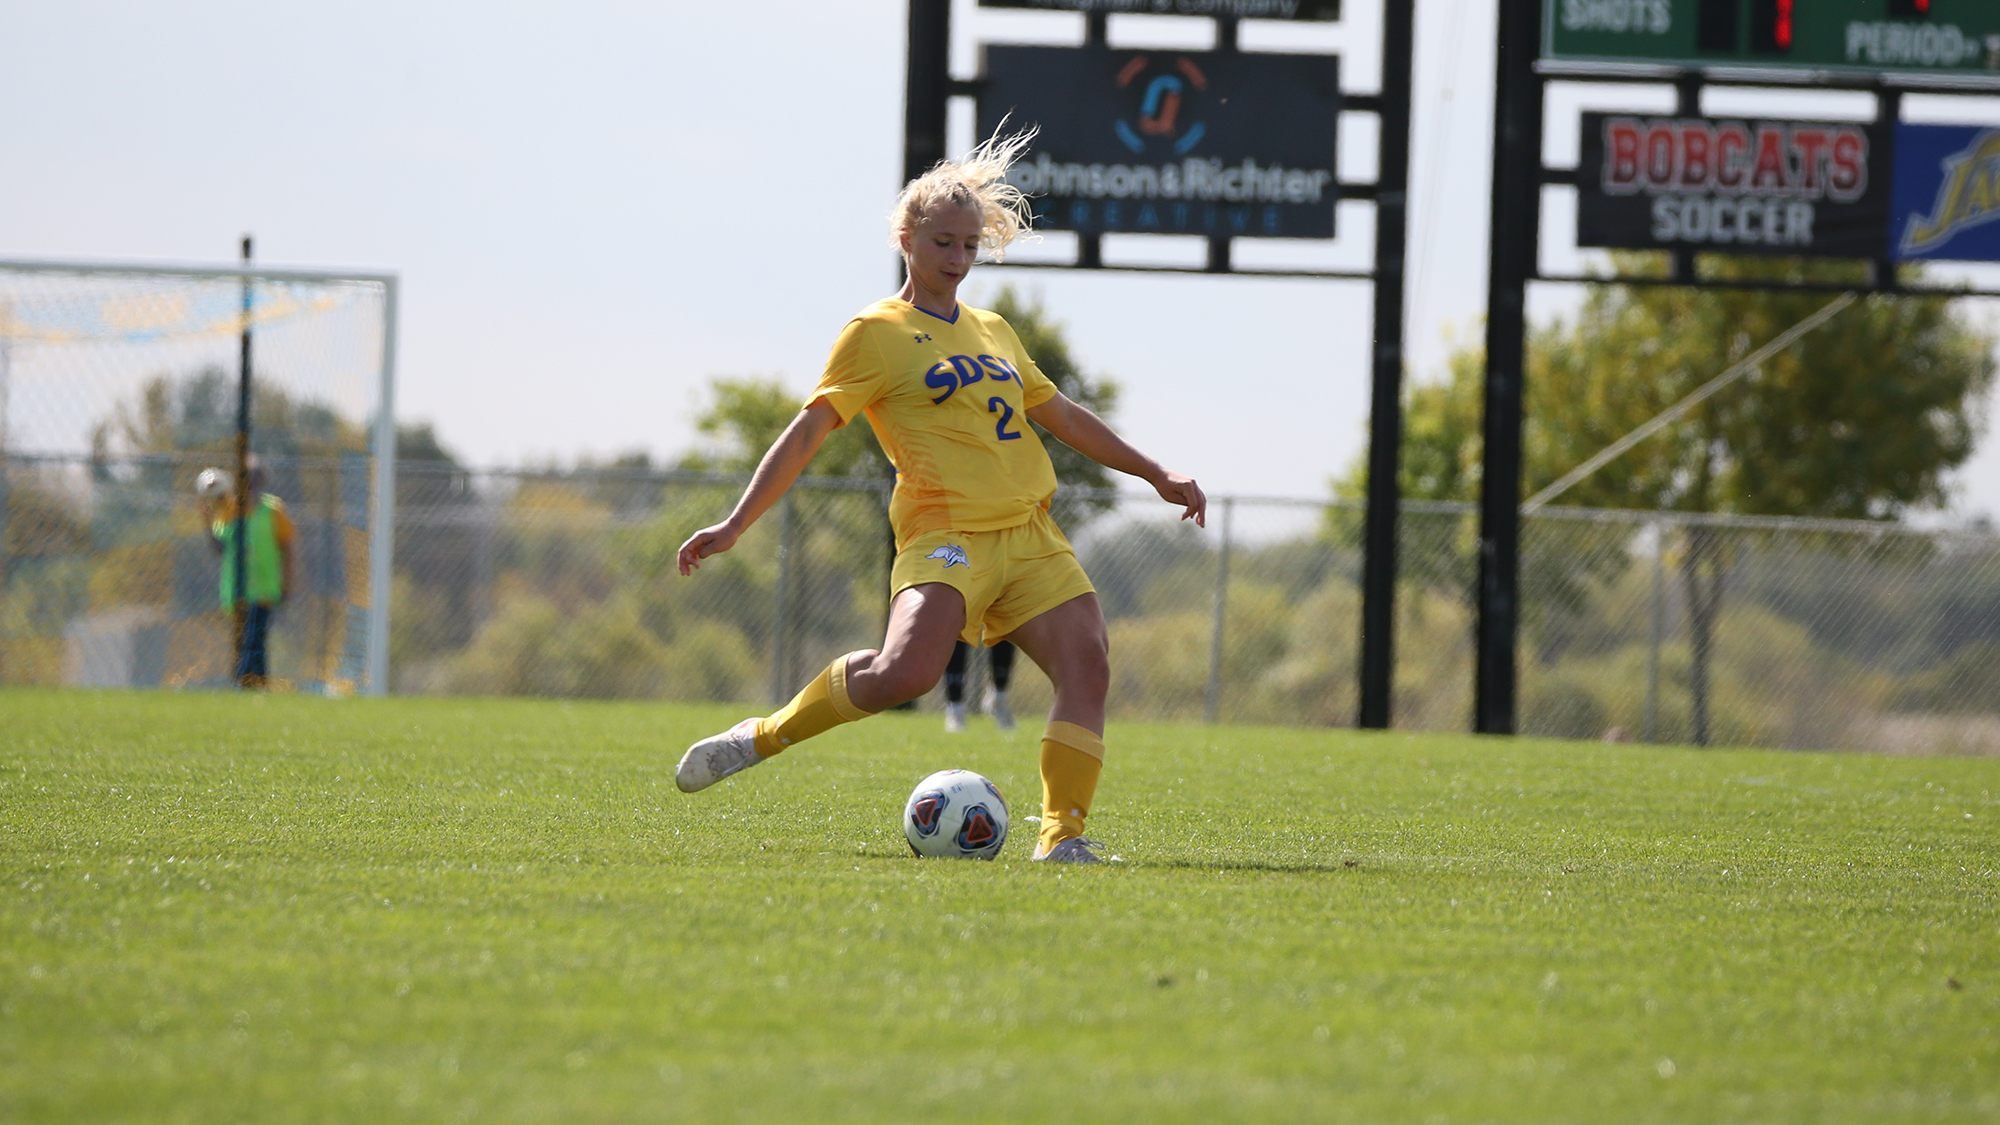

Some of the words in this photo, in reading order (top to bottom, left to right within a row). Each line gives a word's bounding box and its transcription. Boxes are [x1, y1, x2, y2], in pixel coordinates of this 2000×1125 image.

[1561, 0, 1672, 34] SHOTS
[1845, 21, 1963, 66] PERIOD
[1003, 152, 1330, 202] ohnson&Richter
[1603, 117, 1869, 201] BOBCATS
[1651, 198, 1815, 246] SOCCER
[988, 396, 1022, 441] 2
